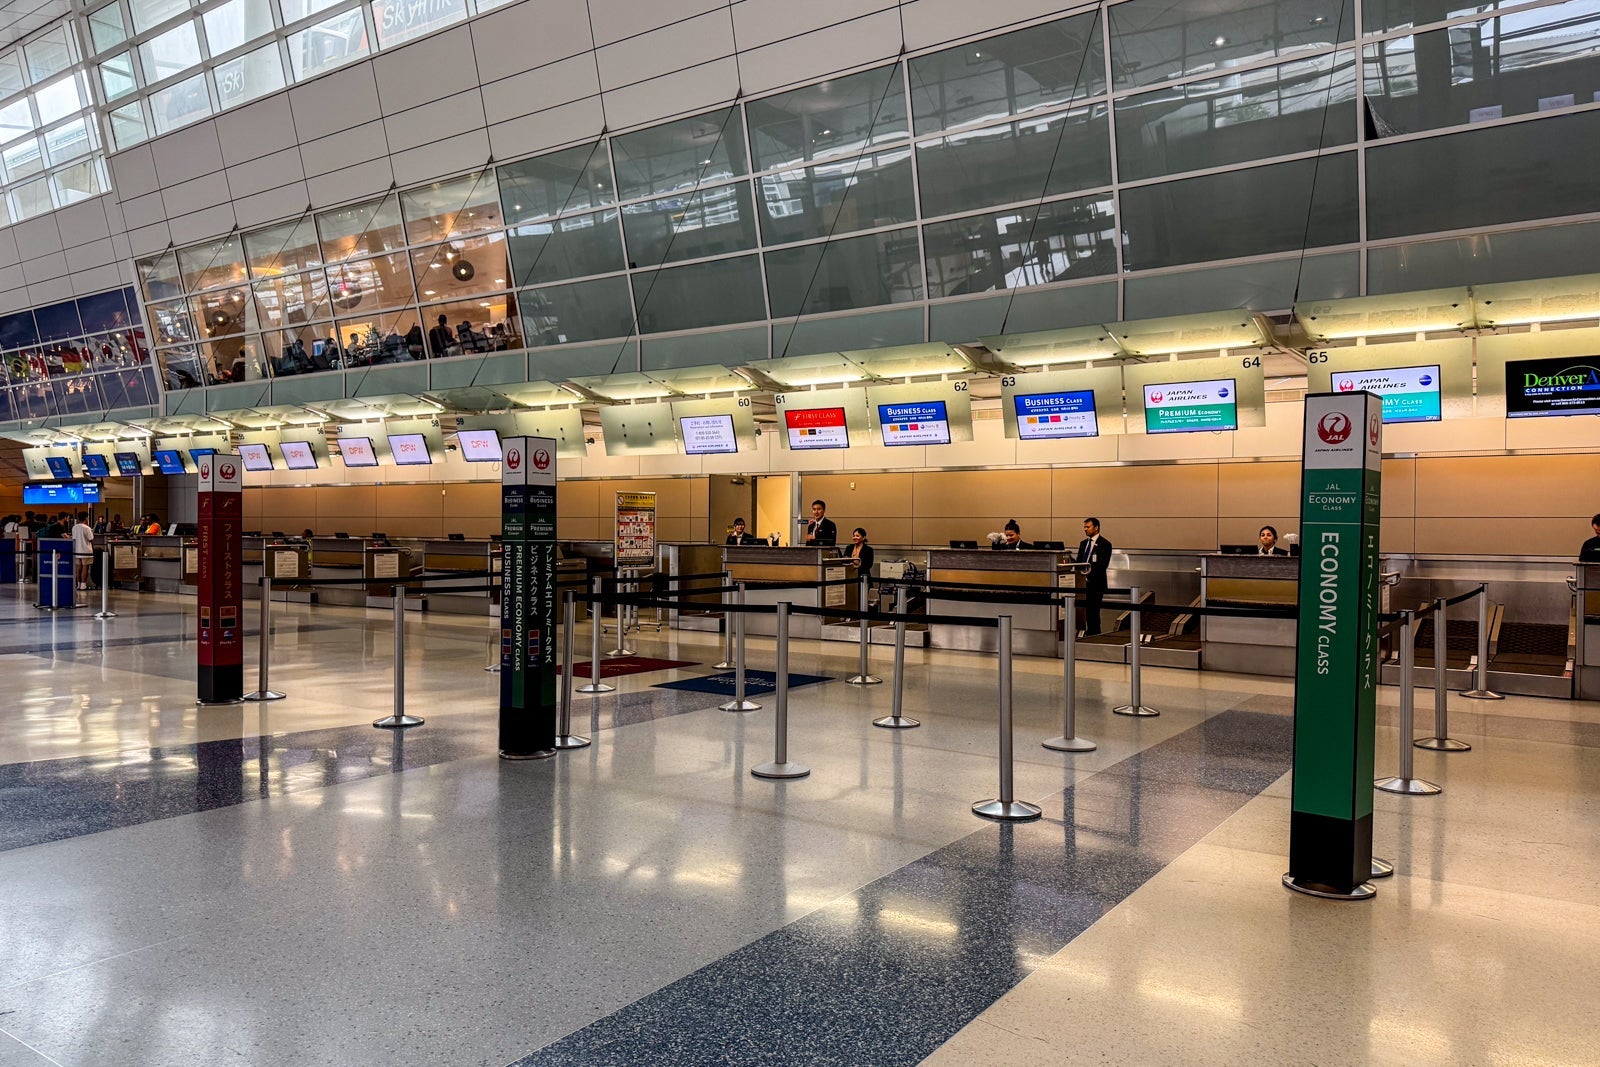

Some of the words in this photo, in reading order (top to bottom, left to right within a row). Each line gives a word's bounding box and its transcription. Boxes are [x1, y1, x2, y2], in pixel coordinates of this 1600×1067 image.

[1242, 356, 1261, 369] 64
[1309, 351, 1328, 364] 65
[954, 381, 967, 391] 62
[1002, 376, 1016, 387] 63
[1357, 377, 1390, 385] JAPAN
[1360, 382, 1407, 390] AIRLINES
[1166, 389, 1193, 397] JAPAN
[1525, 385, 1583, 393] CONNECTION
[738, 398, 750, 407] 60
[775, 395, 786, 404] 61
[1024, 397, 1065, 407] BUSINESS
[1168, 394, 1208, 402] AIRLINES
[887, 407, 921, 416] BUSINESS
[1159, 409, 1197, 417] PREMIUM
[431, 419, 440, 427] 58
[456, 417, 465, 426] 59
[1325, 483, 1340, 491] JAL
[1308, 494, 1357, 504] ECONOMY
[223, 523, 233, 599] ファーストクラス
[515, 545, 523, 595] PREMIUM
[530, 545, 538, 616] ビジネスクラス
[1318, 532, 1340, 634] ECONOMY
[545, 544, 553, 663] プレミアムエコノミークラス
[1364, 535, 1374, 689] エコノミークラス
[515, 596, 523, 648] ECONOMY
[1317, 635, 1330, 675] CLASS
